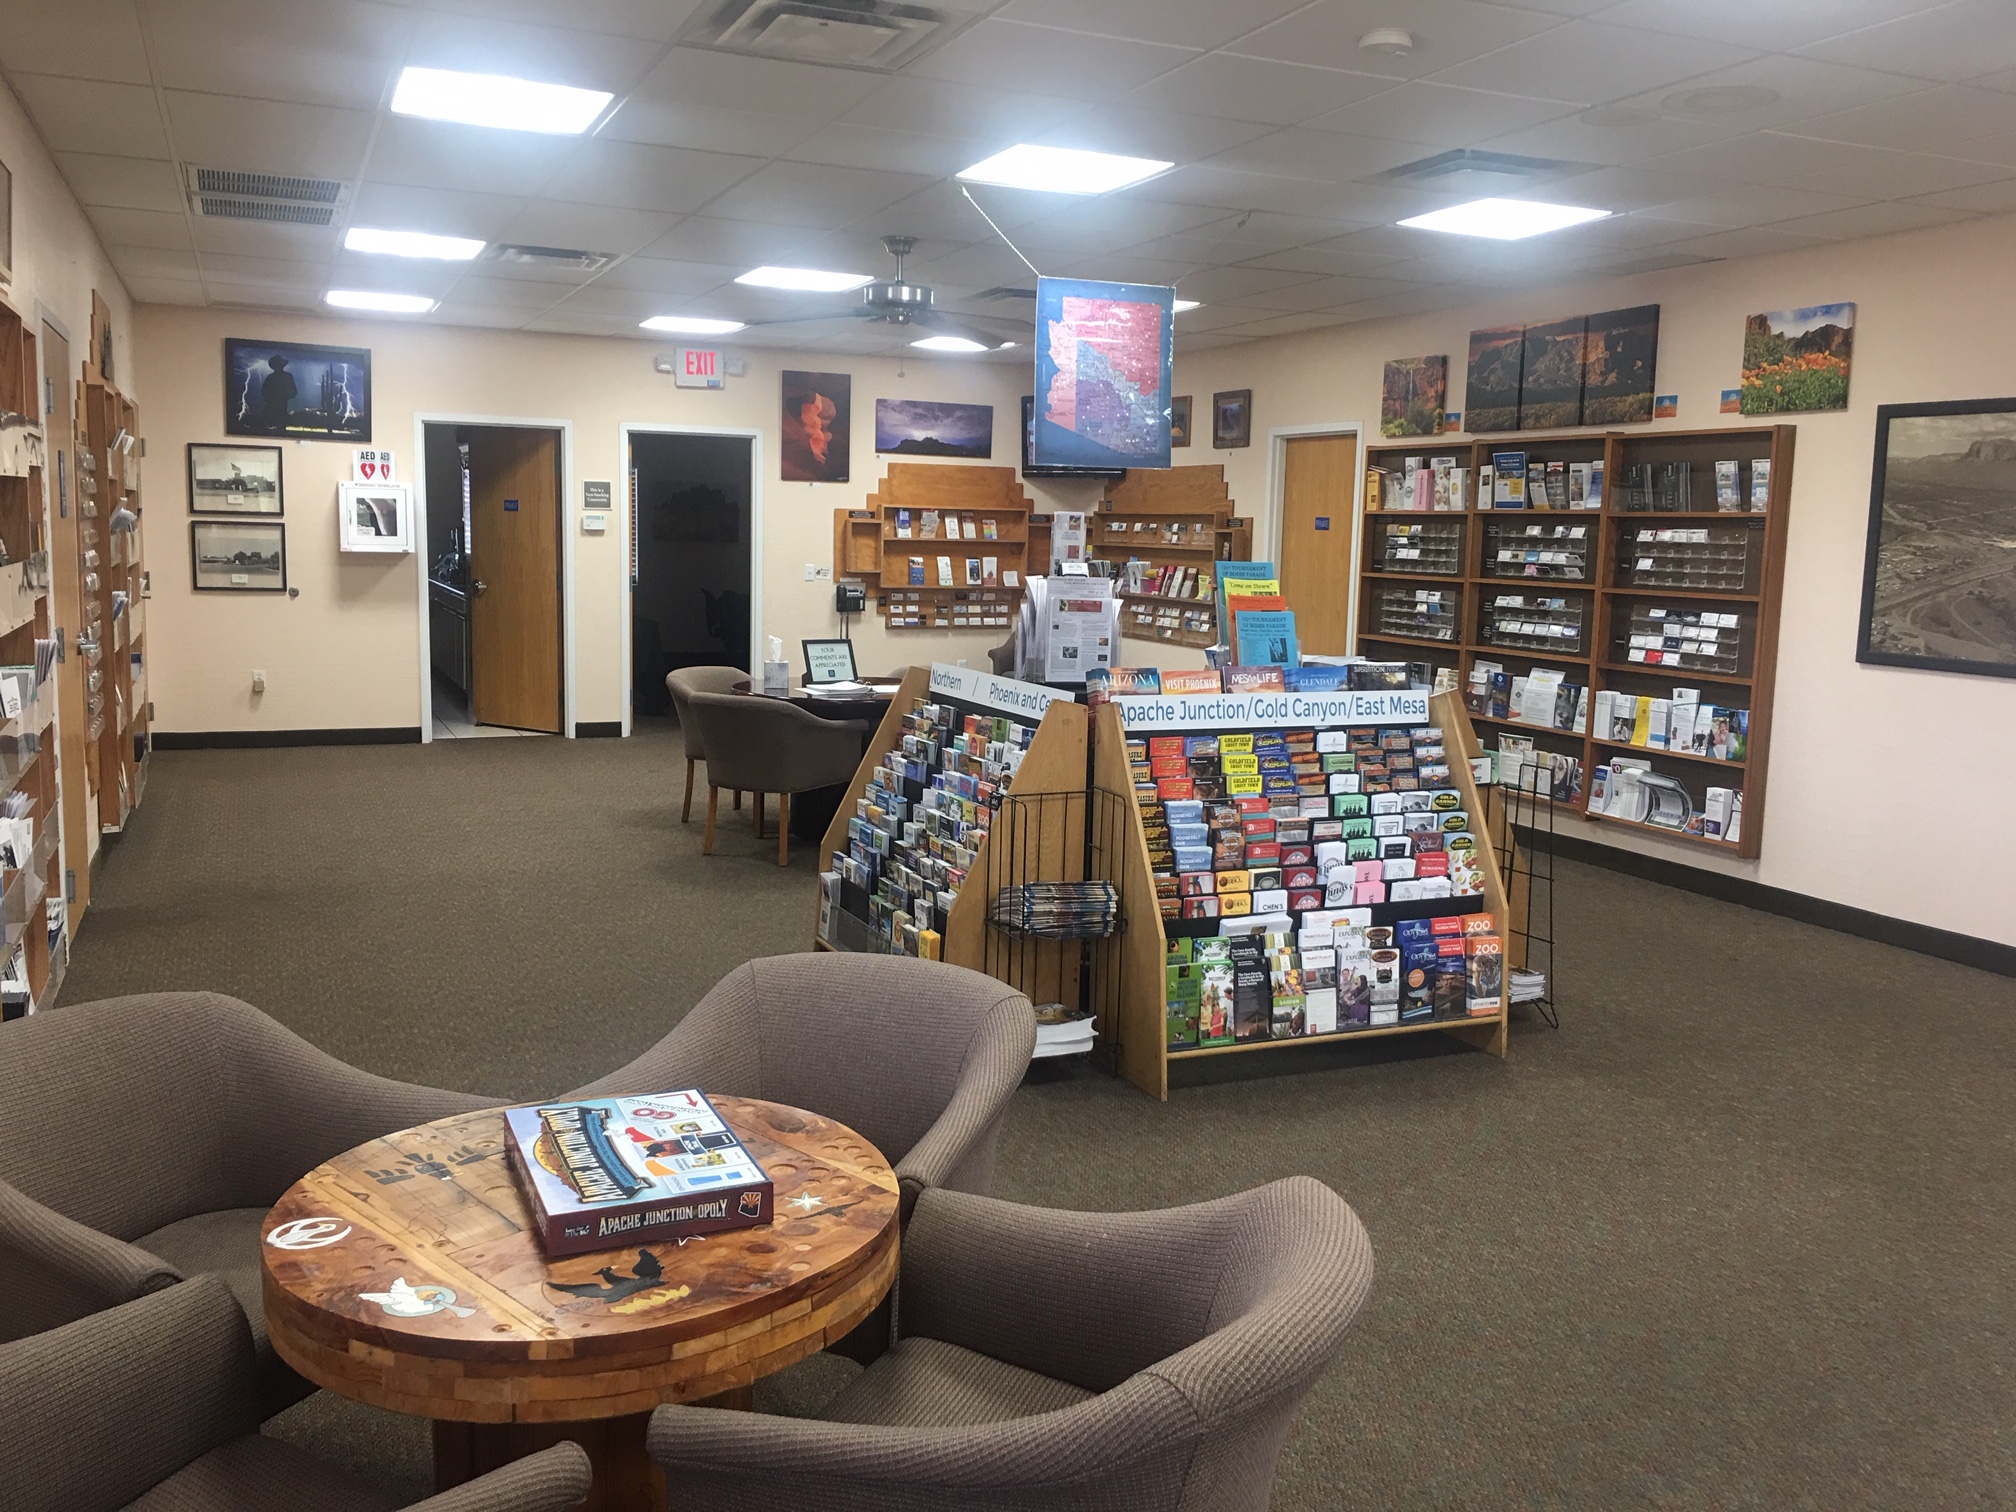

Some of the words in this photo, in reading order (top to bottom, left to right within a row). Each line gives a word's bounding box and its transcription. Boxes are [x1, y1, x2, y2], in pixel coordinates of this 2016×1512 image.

[686, 351, 716, 376] EXIT
[360, 452, 376, 460] AED
[380, 452, 390, 461] AED
[1101, 672, 1155, 686] ARIZONA
[1166, 679, 1184, 690] VISIT
[1185, 678, 1218, 689] PHOENIX
[1231, 674, 1253, 684] MESA
[1256, 673, 1278, 683] LIFE
[1300, 678, 1340, 687] GLENDALE
[932, 668, 962, 691] Northern
[989, 682, 1020, 706] Phoenix
[1021, 692, 1038, 710] and
[1118, 700, 1174, 726] Apache
[1179, 697, 1288, 722] Junction/Gold
[1292, 695, 1385, 722] Canyon/East
[1388, 696, 1425, 716] Mesa
[977, 813, 989, 824] ZOO
[1468, 921, 1491, 931] ZOO
[1476, 944, 1498, 954] ZOO
[632, 1107, 676, 1120] GO
[570, 1168, 628, 1203] APACHE
[599, 1213, 641, 1237] APACHE
[643, 1206, 693, 1228] JUNCTION
[698, 1198, 729, 1219] OPOLY
